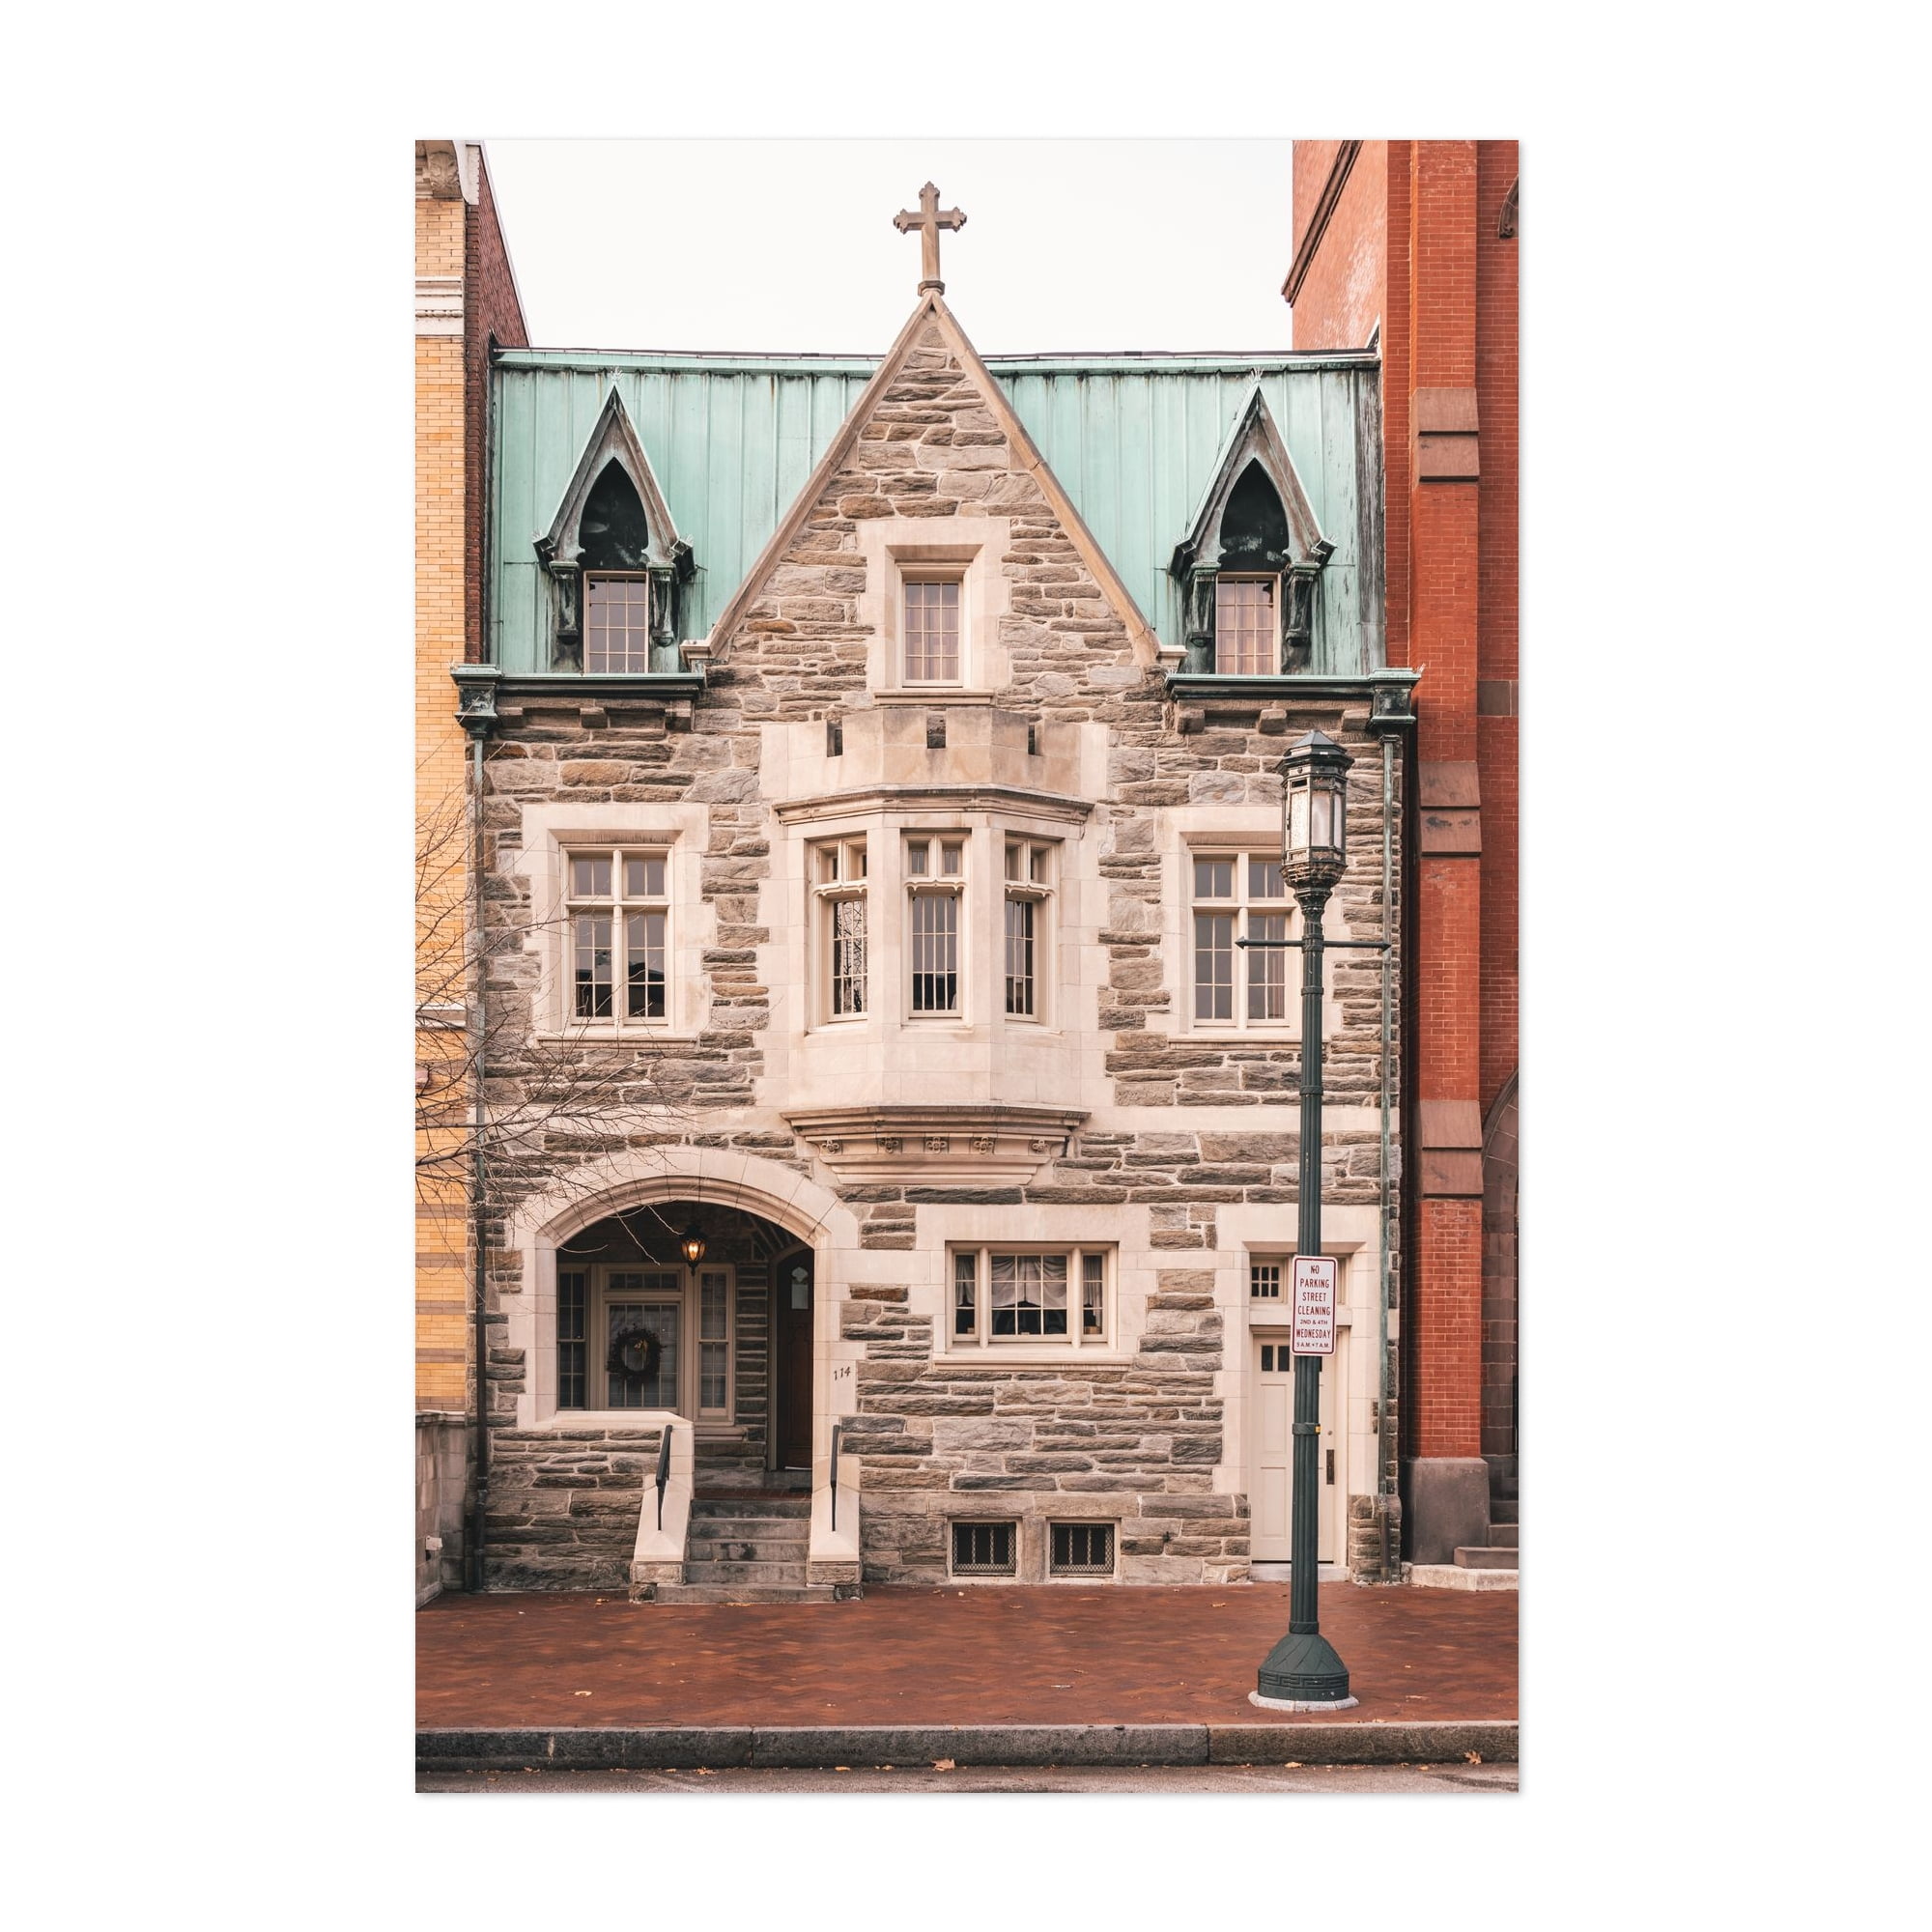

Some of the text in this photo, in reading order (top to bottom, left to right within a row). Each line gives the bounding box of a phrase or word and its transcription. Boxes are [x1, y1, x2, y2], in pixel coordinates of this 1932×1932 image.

[1310, 1264, 1320, 1274] NO
[1299, 1278, 1329, 1289] PARKING
[1302, 1292, 1326, 1302] STREET
[1297, 1305, 1330, 1316] CLEANING
[1296, 1328, 1331, 1339] WEDNESDAY
[834, 1366, 850, 1381] 114
